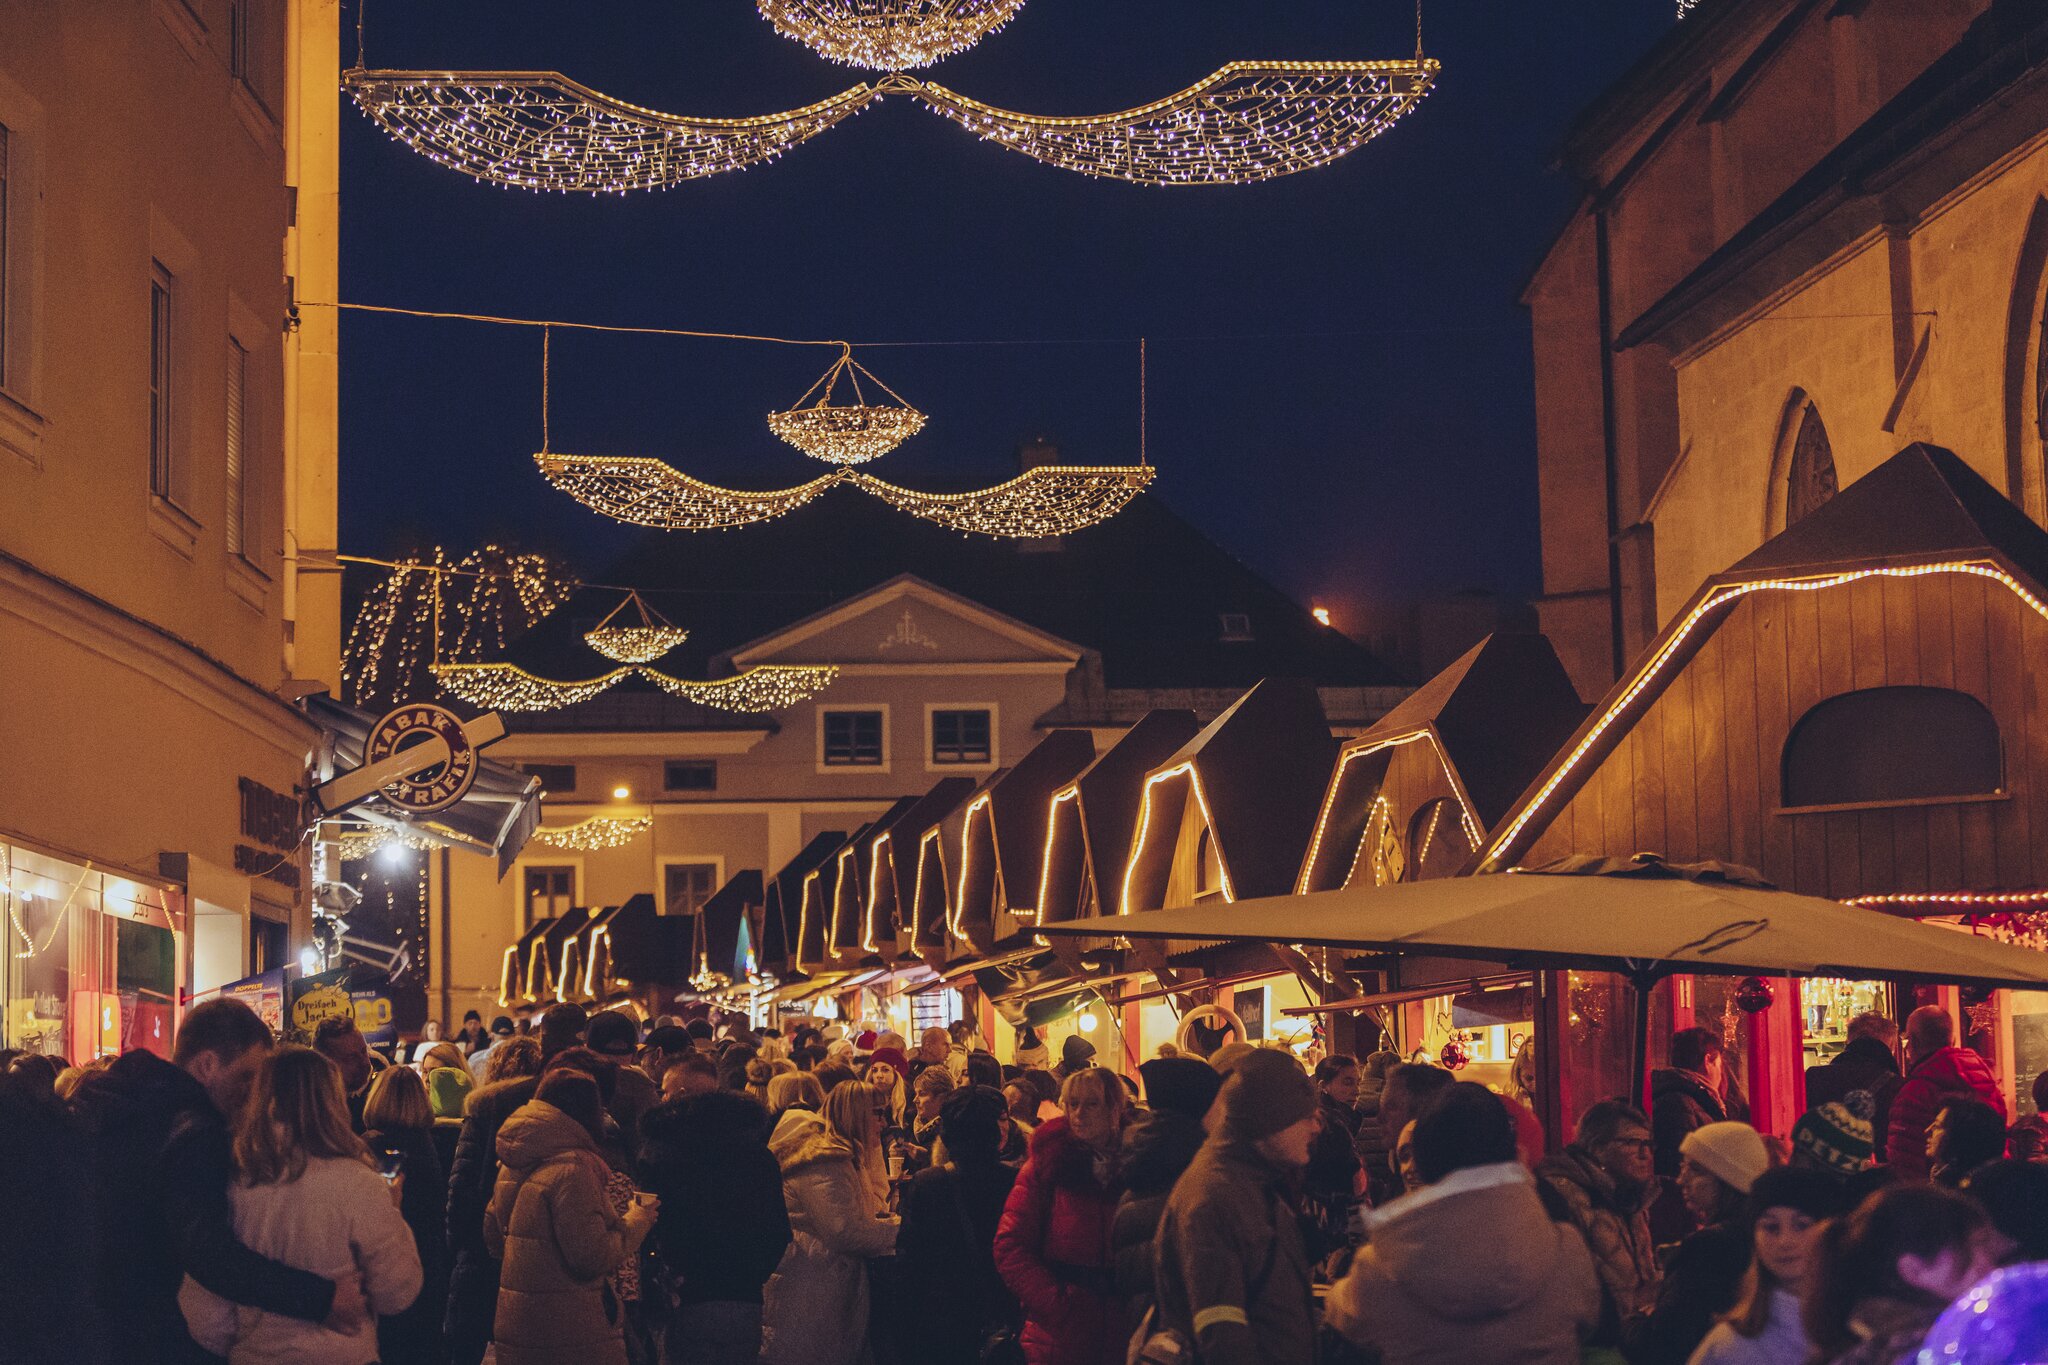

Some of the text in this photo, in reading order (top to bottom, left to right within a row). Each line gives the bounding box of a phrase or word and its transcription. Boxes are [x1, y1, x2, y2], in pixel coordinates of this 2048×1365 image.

[375, 711, 452, 754] TABAK
[398, 749, 468, 804] TRAFIK
[297, 998, 337, 1011] Dreifach
